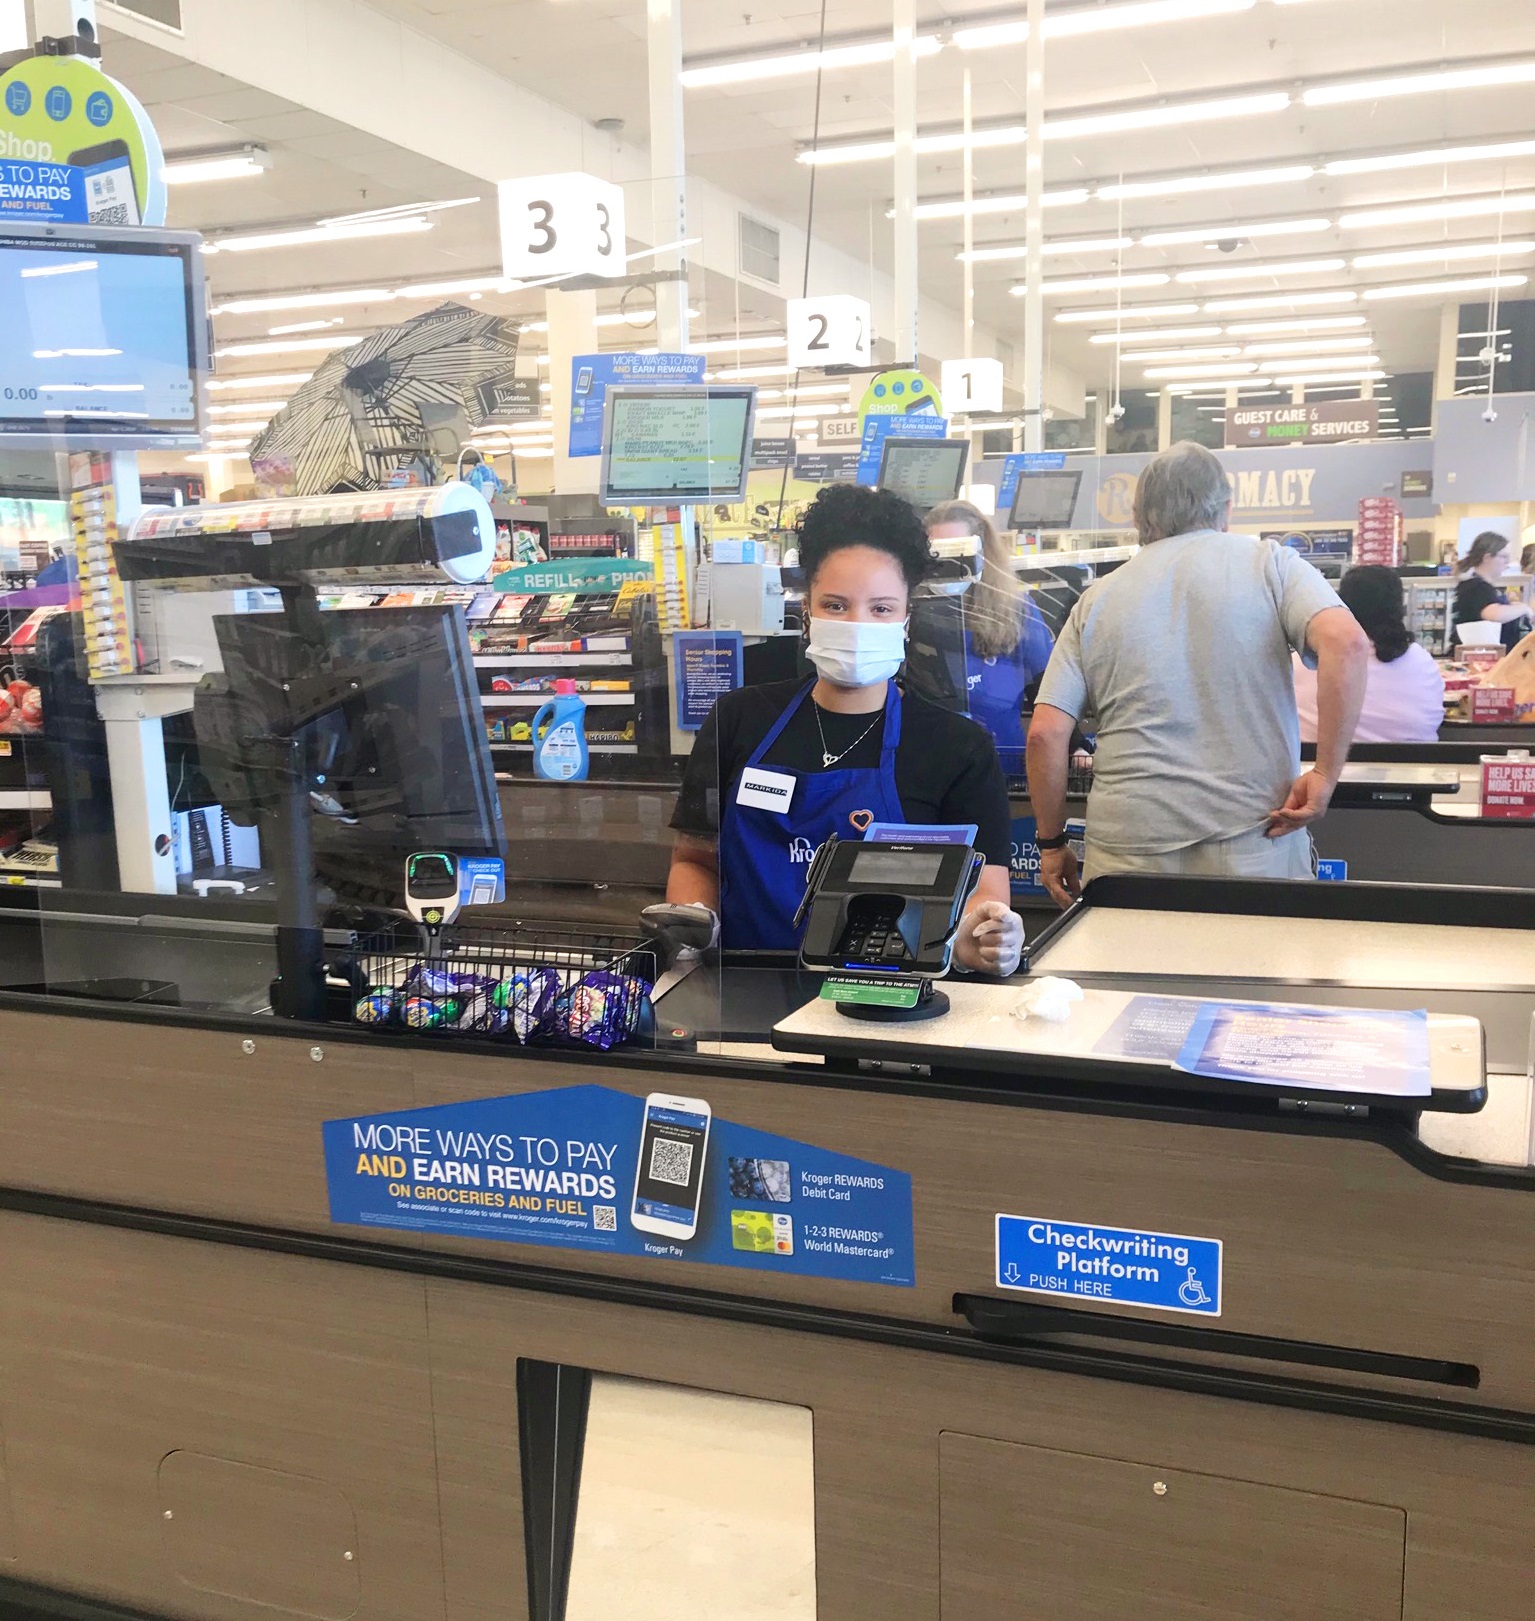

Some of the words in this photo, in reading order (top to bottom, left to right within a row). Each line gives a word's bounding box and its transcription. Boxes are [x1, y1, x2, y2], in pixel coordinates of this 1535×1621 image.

[6, 166, 34, 183] TO
[38, 167, 71, 184] PAY
[0, 183, 71, 200] EWARDS
[1, 201, 23, 209] AND
[26, 202, 53, 210] FUEL
[527, 200, 557, 254] 3
[596, 202, 613, 256] 3
[807, 313, 829, 350] 2
[613, 356, 640, 365] MORE
[641, 356, 667, 365] WAYS
[669, 356, 681, 365] TO
[683, 356, 700, 365] PAY
[613, 365, 630, 374] AND
[632, 365, 655, 373] EARN
[657, 365, 698, 373] REWARDS
[4, 387, 38, 400] 0.00
[961, 372, 972, 399] 1
[500, 407, 530, 415] vegetables
[869, 404, 898, 414] Shop
[1234, 410, 1273, 424] GUEST
[1274, 409, 1306, 422] CARE
[1310, 408, 1319, 421] &
[827, 423, 857, 435] SELF
[1266, 424, 1309, 437] MONEY
[1311, 421, 1370, 436] SERVICES
[1229, 468, 1316, 508] MACY
[524, 573, 578, 588] REFILL
[967, 673, 982, 690] ger
[1489, 767, 1510, 779] HELP
[1511, 767, 1524, 779] US
[1524, 767, 1535, 780] SA
[746, 783, 788, 796] MARKIDA
[1488, 779, 1513, 792] MORE
[1487, 795, 1508, 804] DONATE
[789, 837, 815, 864] Kro
[1022, 842, 1041, 856] PA
[353, 1122, 432, 1155] MORE
[436, 1129, 515, 1163] WAYS
[519, 1135, 559, 1166] TO
[567, 1140, 618, 1171] PAY
[356, 1153, 407, 1178] AND
[413, 1158, 480, 1186] EARN
[487, 1164, 616, 1199] REWARDS
[801, 1171, 832, 1185] Kroger
[834, 1174, 884, 1190] REWARDS
[389, 1182, 411, 1198] ON
[415, 1185, 504, 1208] GROCERIES
[508, 1194, 542, 1212] AND
[545, 1198, 588, 1216] FUEL
[802, 1186, 827, 1199] Debit
[828, 1188, 851, 1201] Card
[397, 1200, 410, 1209] See
[411, 1203, 440, 1212] associate
[448, 1207, 464, 1215] scan
[465, 1208, 481, 1217] code
[481, 1209, 488, 1217] to
[488, 1210, 502, 1219] visit
[502, 1212, 588, 1229] www.kroger.com/krogerpay
[804, 1225, 827, 1237] 1-2-3
[644, 1243, 668, 1255] Kroger
[670, 1245, 683, 1257] Pay
[804, 1239, 832, 1252] World
[1027, 1224, 1189, 1267] Checkwriting
[1057, 1251, 1159, 1283] Platform
[1029, 1273, 1068, 1291] PUSH
[1074, 1279, 1112, 1297] HERE
